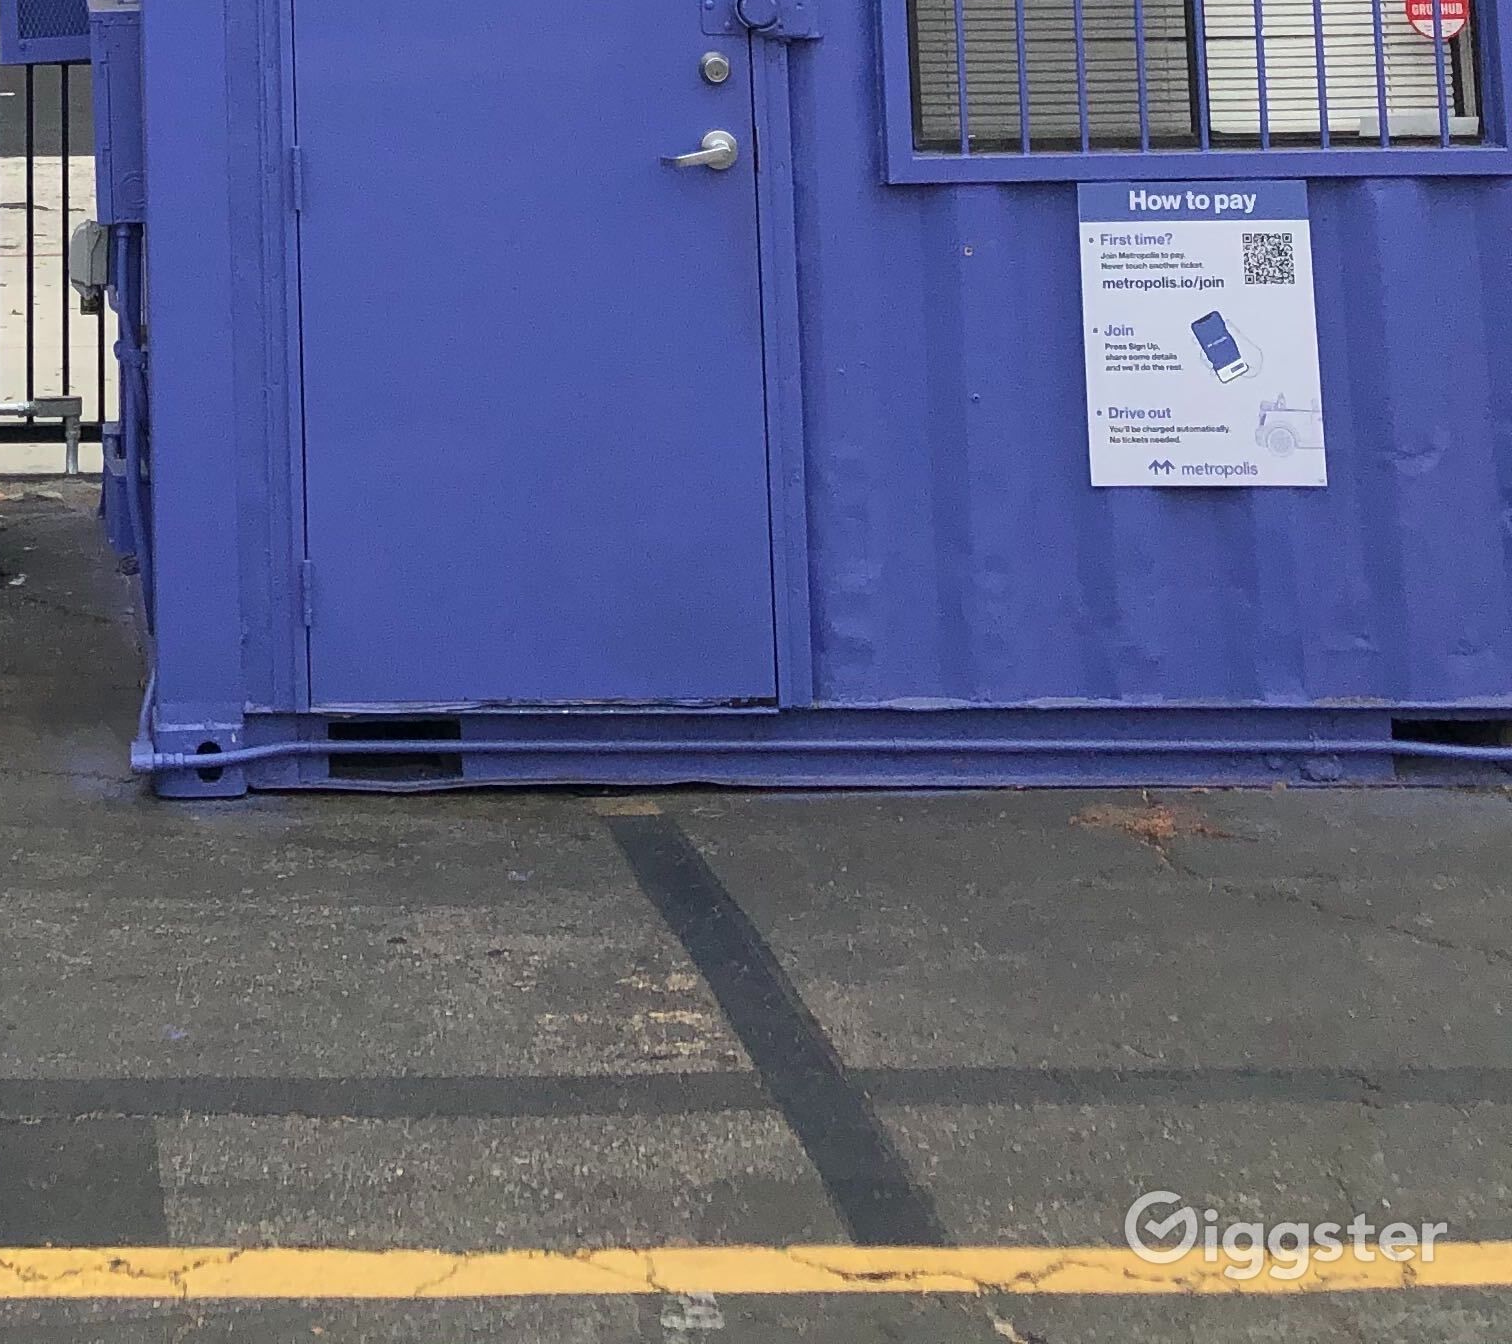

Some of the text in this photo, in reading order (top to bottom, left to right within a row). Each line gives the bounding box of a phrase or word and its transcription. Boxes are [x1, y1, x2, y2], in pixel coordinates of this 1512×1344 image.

[1411, 2, 1463, 16] GRUHUB
[1129, 190, 1257, 213] How to pay
[1100, 232, 1173, 246] First time?
[1102, 276, 1225, 291] metropolis.io/join
[1104, 324, 1135, 336] Join
[1108, 407, 1172, 419] Drive out
[1181, 461, 1258, 479] metropolis
